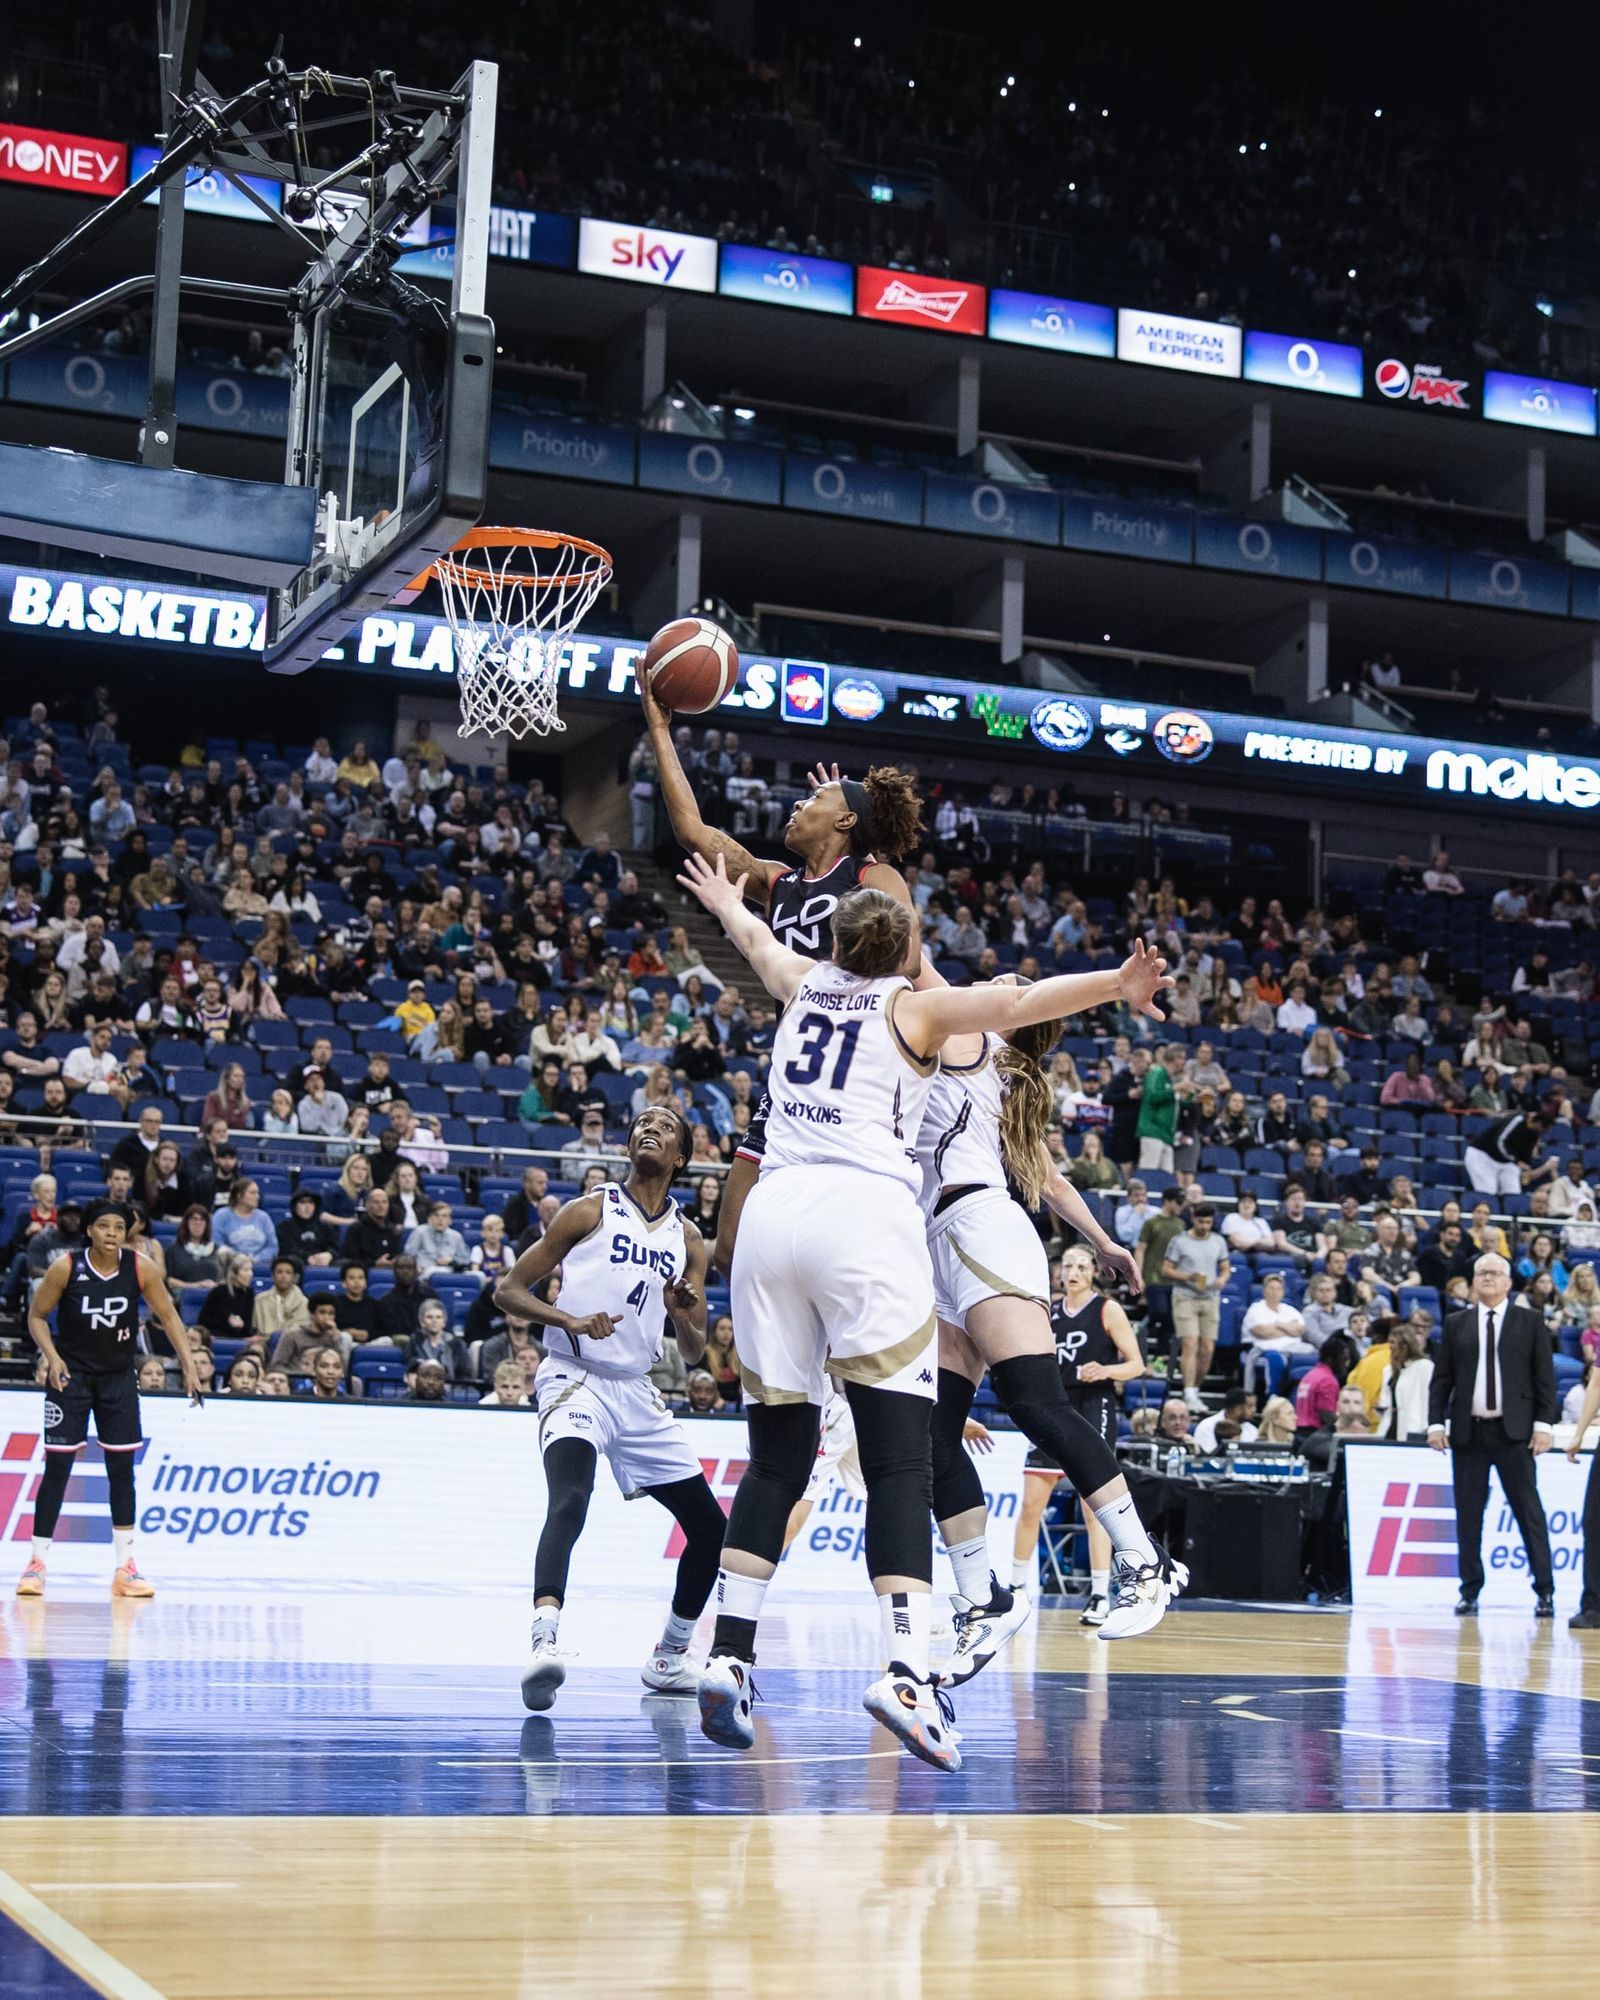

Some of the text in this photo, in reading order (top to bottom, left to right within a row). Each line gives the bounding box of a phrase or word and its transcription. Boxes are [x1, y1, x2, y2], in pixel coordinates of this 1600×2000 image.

[489, 206, 535, 260] IAT
[611, 231, 685, 282] sky
[1136, 324, 1223, 349] AMERICAN
[1148, 341, 1224, 364] EXPRESS
[1287, 343, 1326, 386] O2
[522, 429, 605, 466] Priority
[687, 443, 732, 496] O2
[1093, 511, 1168, 546] Priority
[9, 576, 344, 660] BASKETB
[1244, 732, 1372, 770] PRESENTED
[1374, 747, 1408, 774] BY
[800, 984, 881, 1011] CHOOSE LOVE
[784, 1012, 863, 1090] 31
[152, 1454, 381, 1499] innovation
[139, 1502, 310, 1544] esports
[892, 1610, 911, 1636] NIKE
